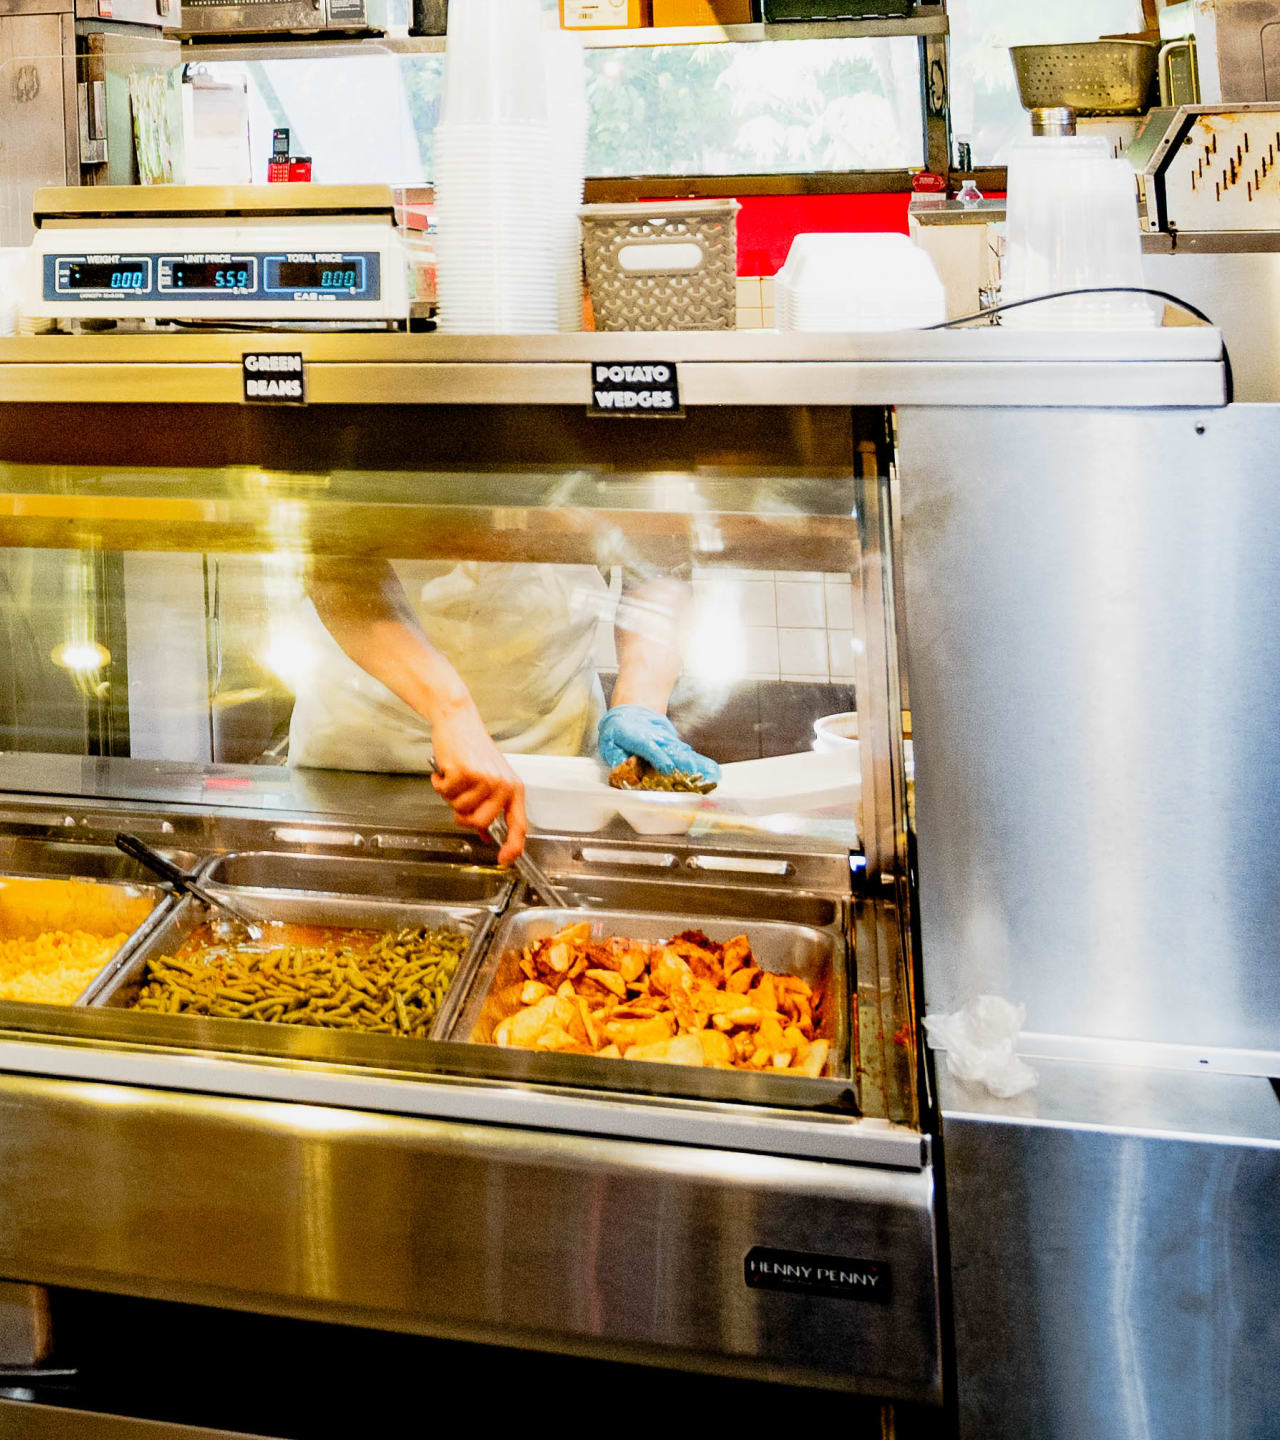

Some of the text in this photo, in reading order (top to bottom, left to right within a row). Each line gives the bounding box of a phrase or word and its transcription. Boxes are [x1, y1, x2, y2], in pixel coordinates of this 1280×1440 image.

[87, 255, 120, 264] WEIGHT
[183, 254, 205, 264] UNIT
[287, 254, 315, 263] TOTAL
[244, 355, 301, 372] GREEN
[596, 365, 671, 383] POTATO
[246, 379, 302, 396] BEANS
[594, 390, 674, 408] WEDGES
[750, 1259, 813, 1279] HENNY
[816, 1268, 880, 1287] PENNY
